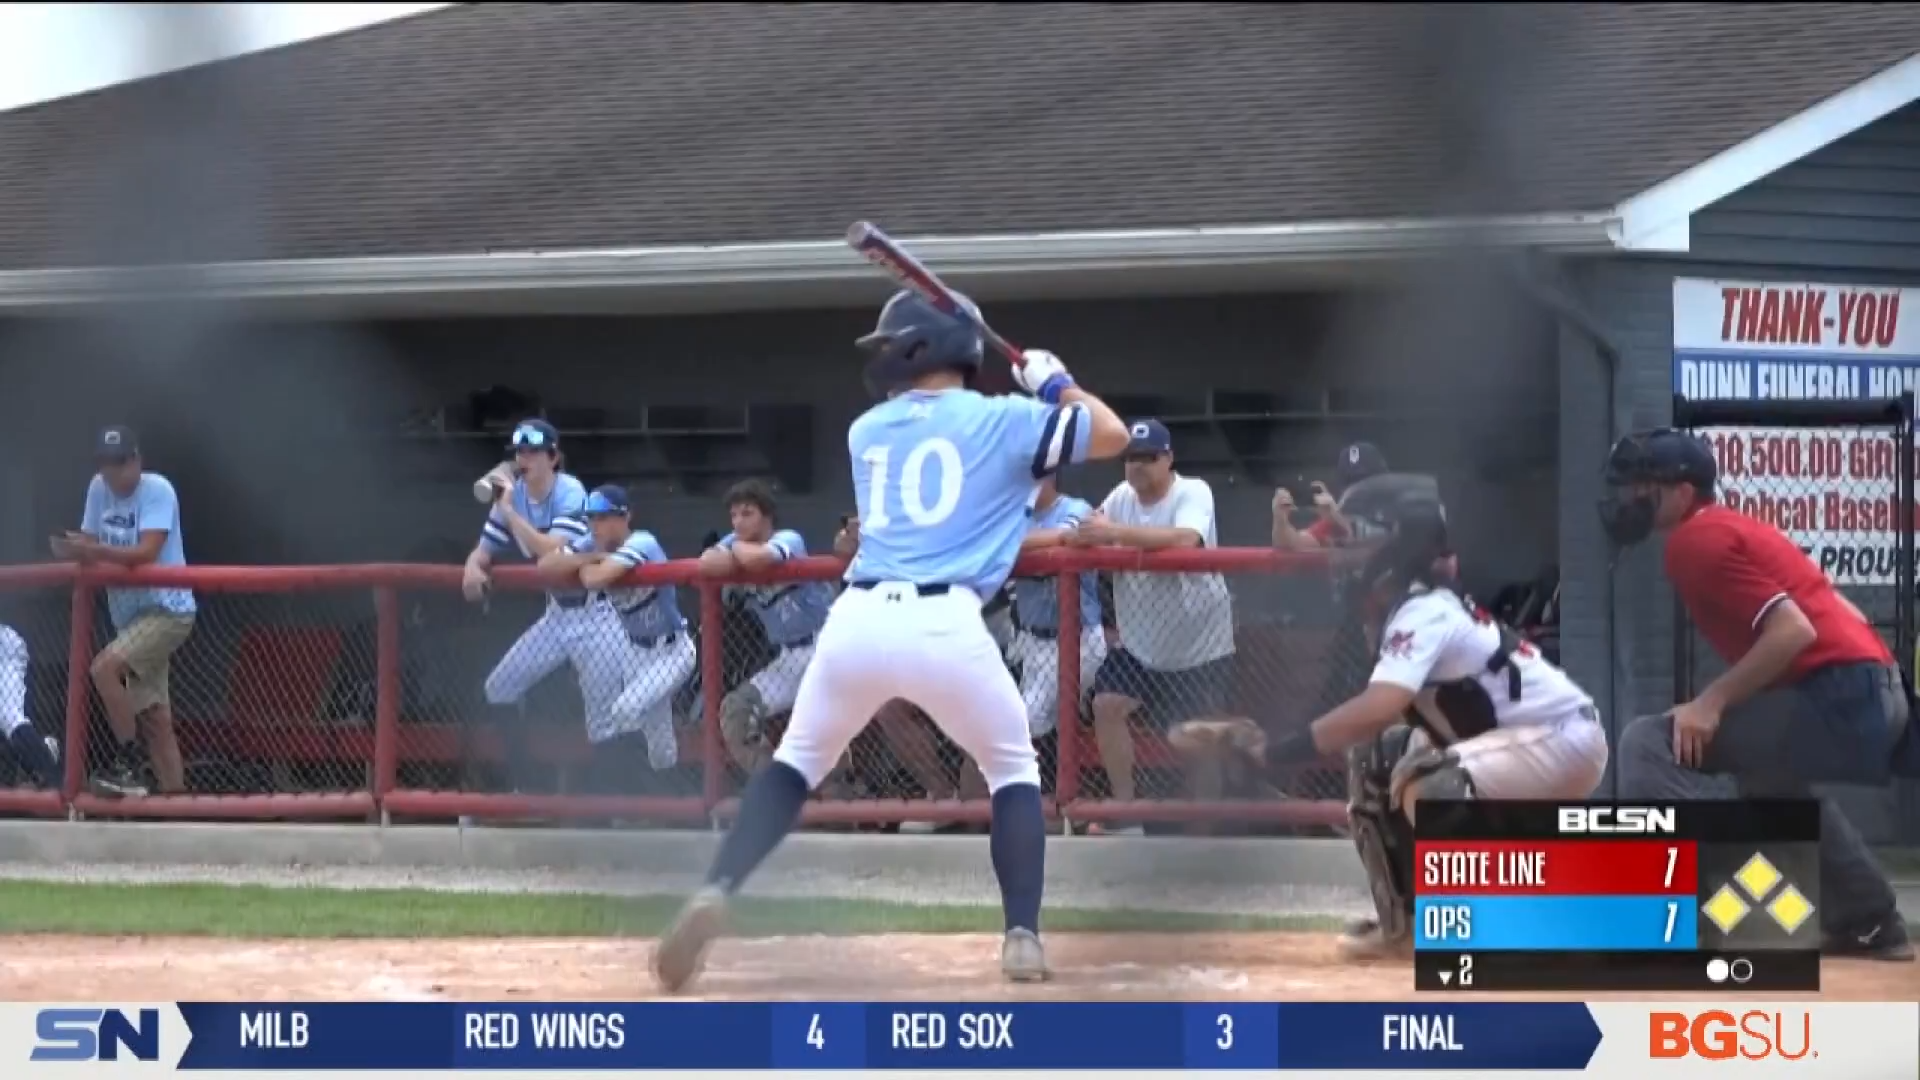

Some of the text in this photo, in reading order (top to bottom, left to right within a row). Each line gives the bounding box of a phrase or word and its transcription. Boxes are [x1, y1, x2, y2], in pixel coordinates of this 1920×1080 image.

[1721, 287, 1900, 348] THANK-YOU
[1681, 359, 1751, 401] DUNN
[1757, 361, 1861, 401] FUNERAL
[862, 437, 964, 530] 10
[1820, 546, 1900, 577] PROU
